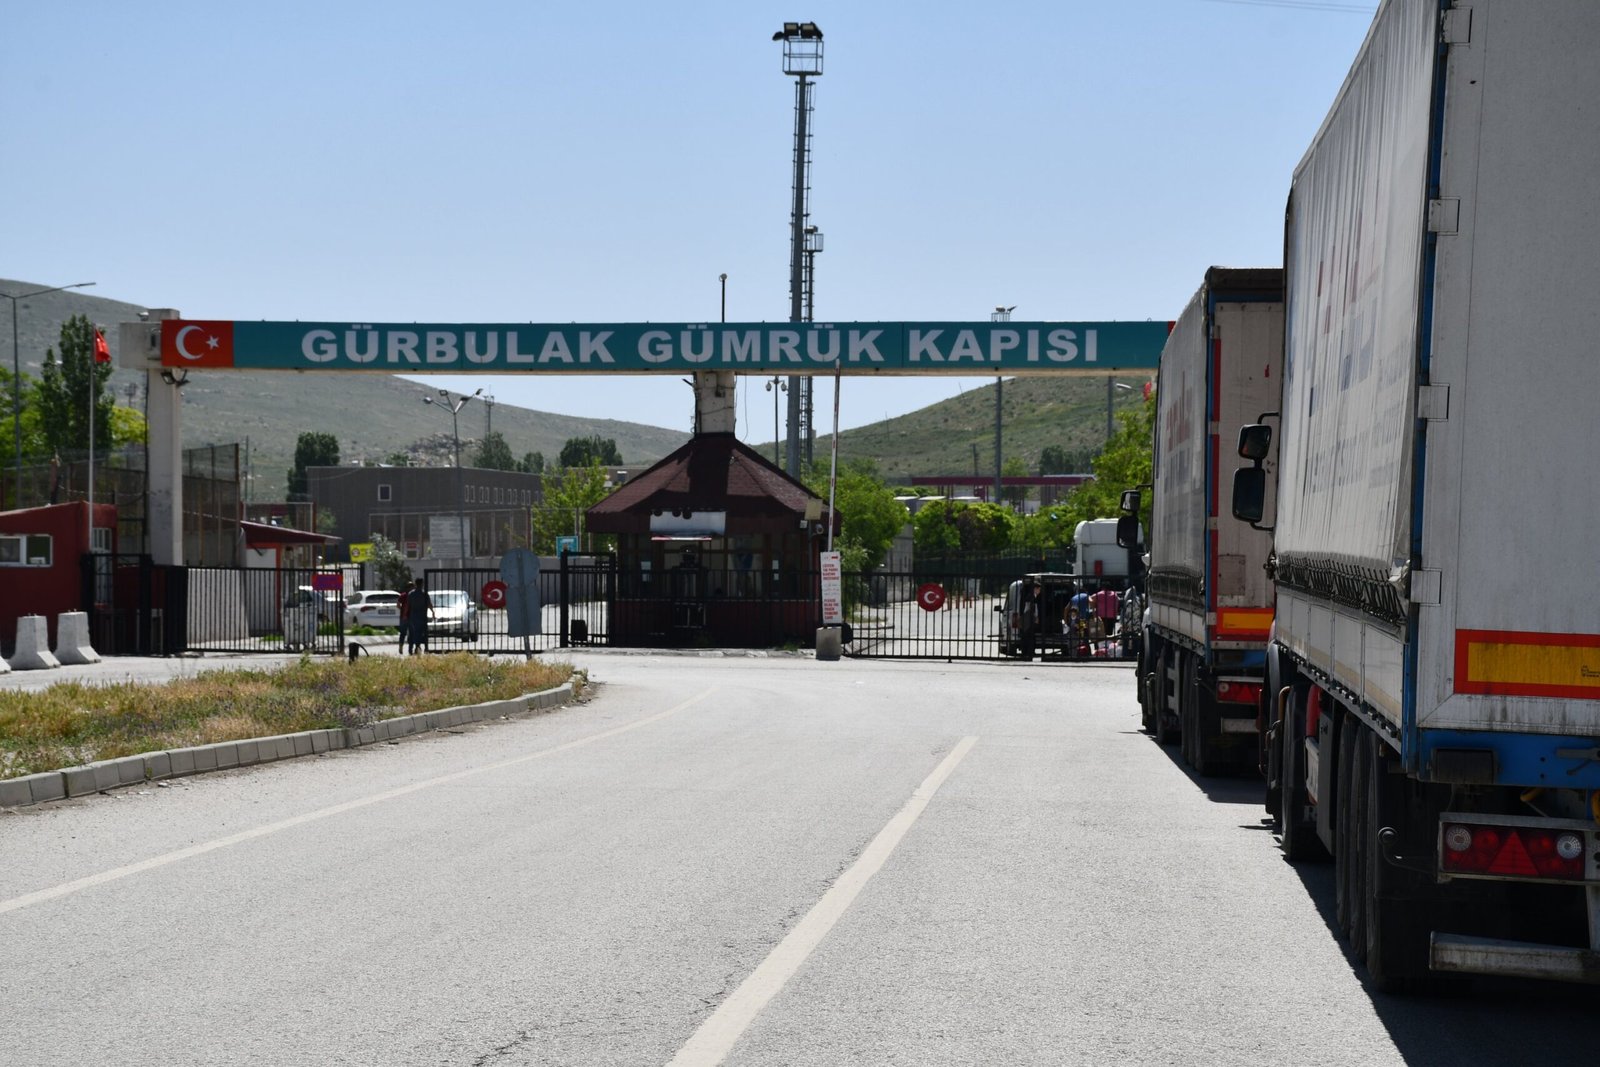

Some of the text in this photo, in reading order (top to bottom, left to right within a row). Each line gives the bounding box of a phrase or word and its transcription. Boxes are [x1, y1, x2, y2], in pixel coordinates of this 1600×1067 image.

[301, 324, 1098, 363] GÜRBULAK GÜMRÜK KAPISI
